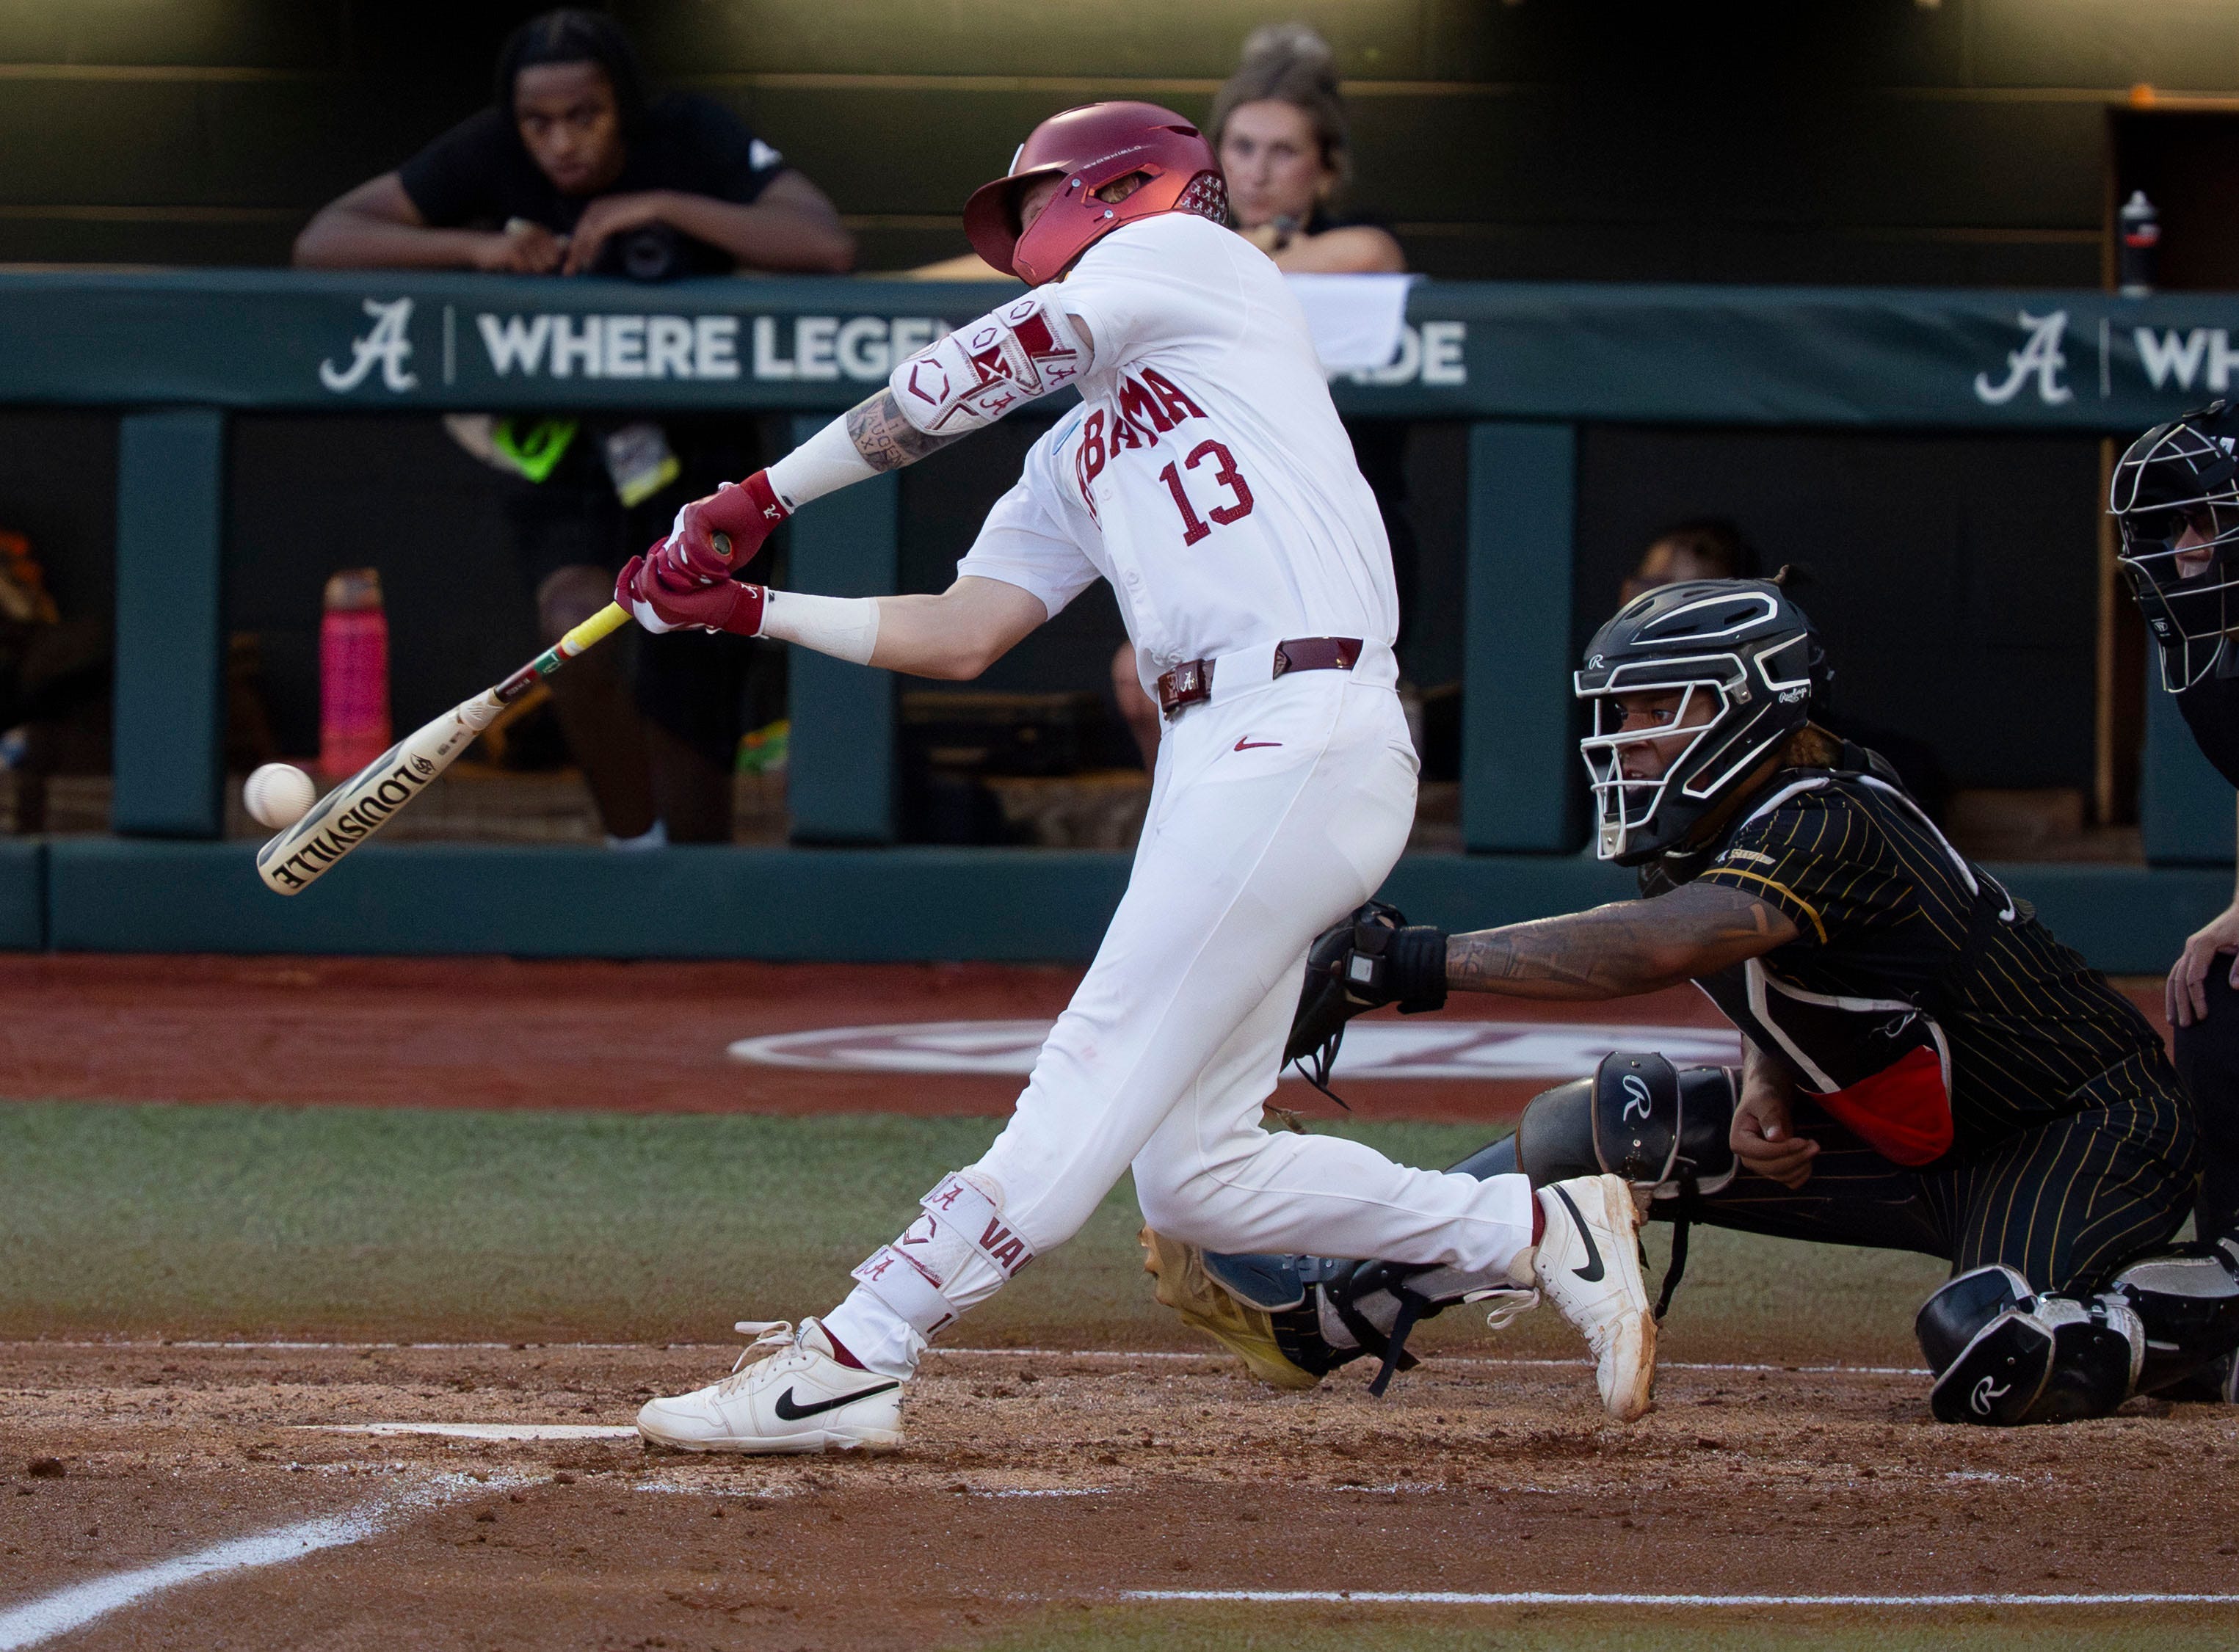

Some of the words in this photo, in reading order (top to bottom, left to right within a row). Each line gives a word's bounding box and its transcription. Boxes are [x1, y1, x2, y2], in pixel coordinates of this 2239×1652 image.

[319, 296, 418, 393] A
[476, 313, 740, 378] WHERE
[753, 316, 953, 380] LEGE
[1975, 310, 2073, 405] A
[979, 391, 1017, 415] A
[1075, 367, 1211, 521] BAMA
[1159, 439, 1254, 547] 13
[1589, 654, 1605, 670] R
[271, 764, 427, 889] LOUISVILLE
[1623, 1074, 1652, 1122] R
[932, 1183, 964, 1211] A
[863, 1255, 894, 1282] A
[1970, 1375, 2011, 1415] R
